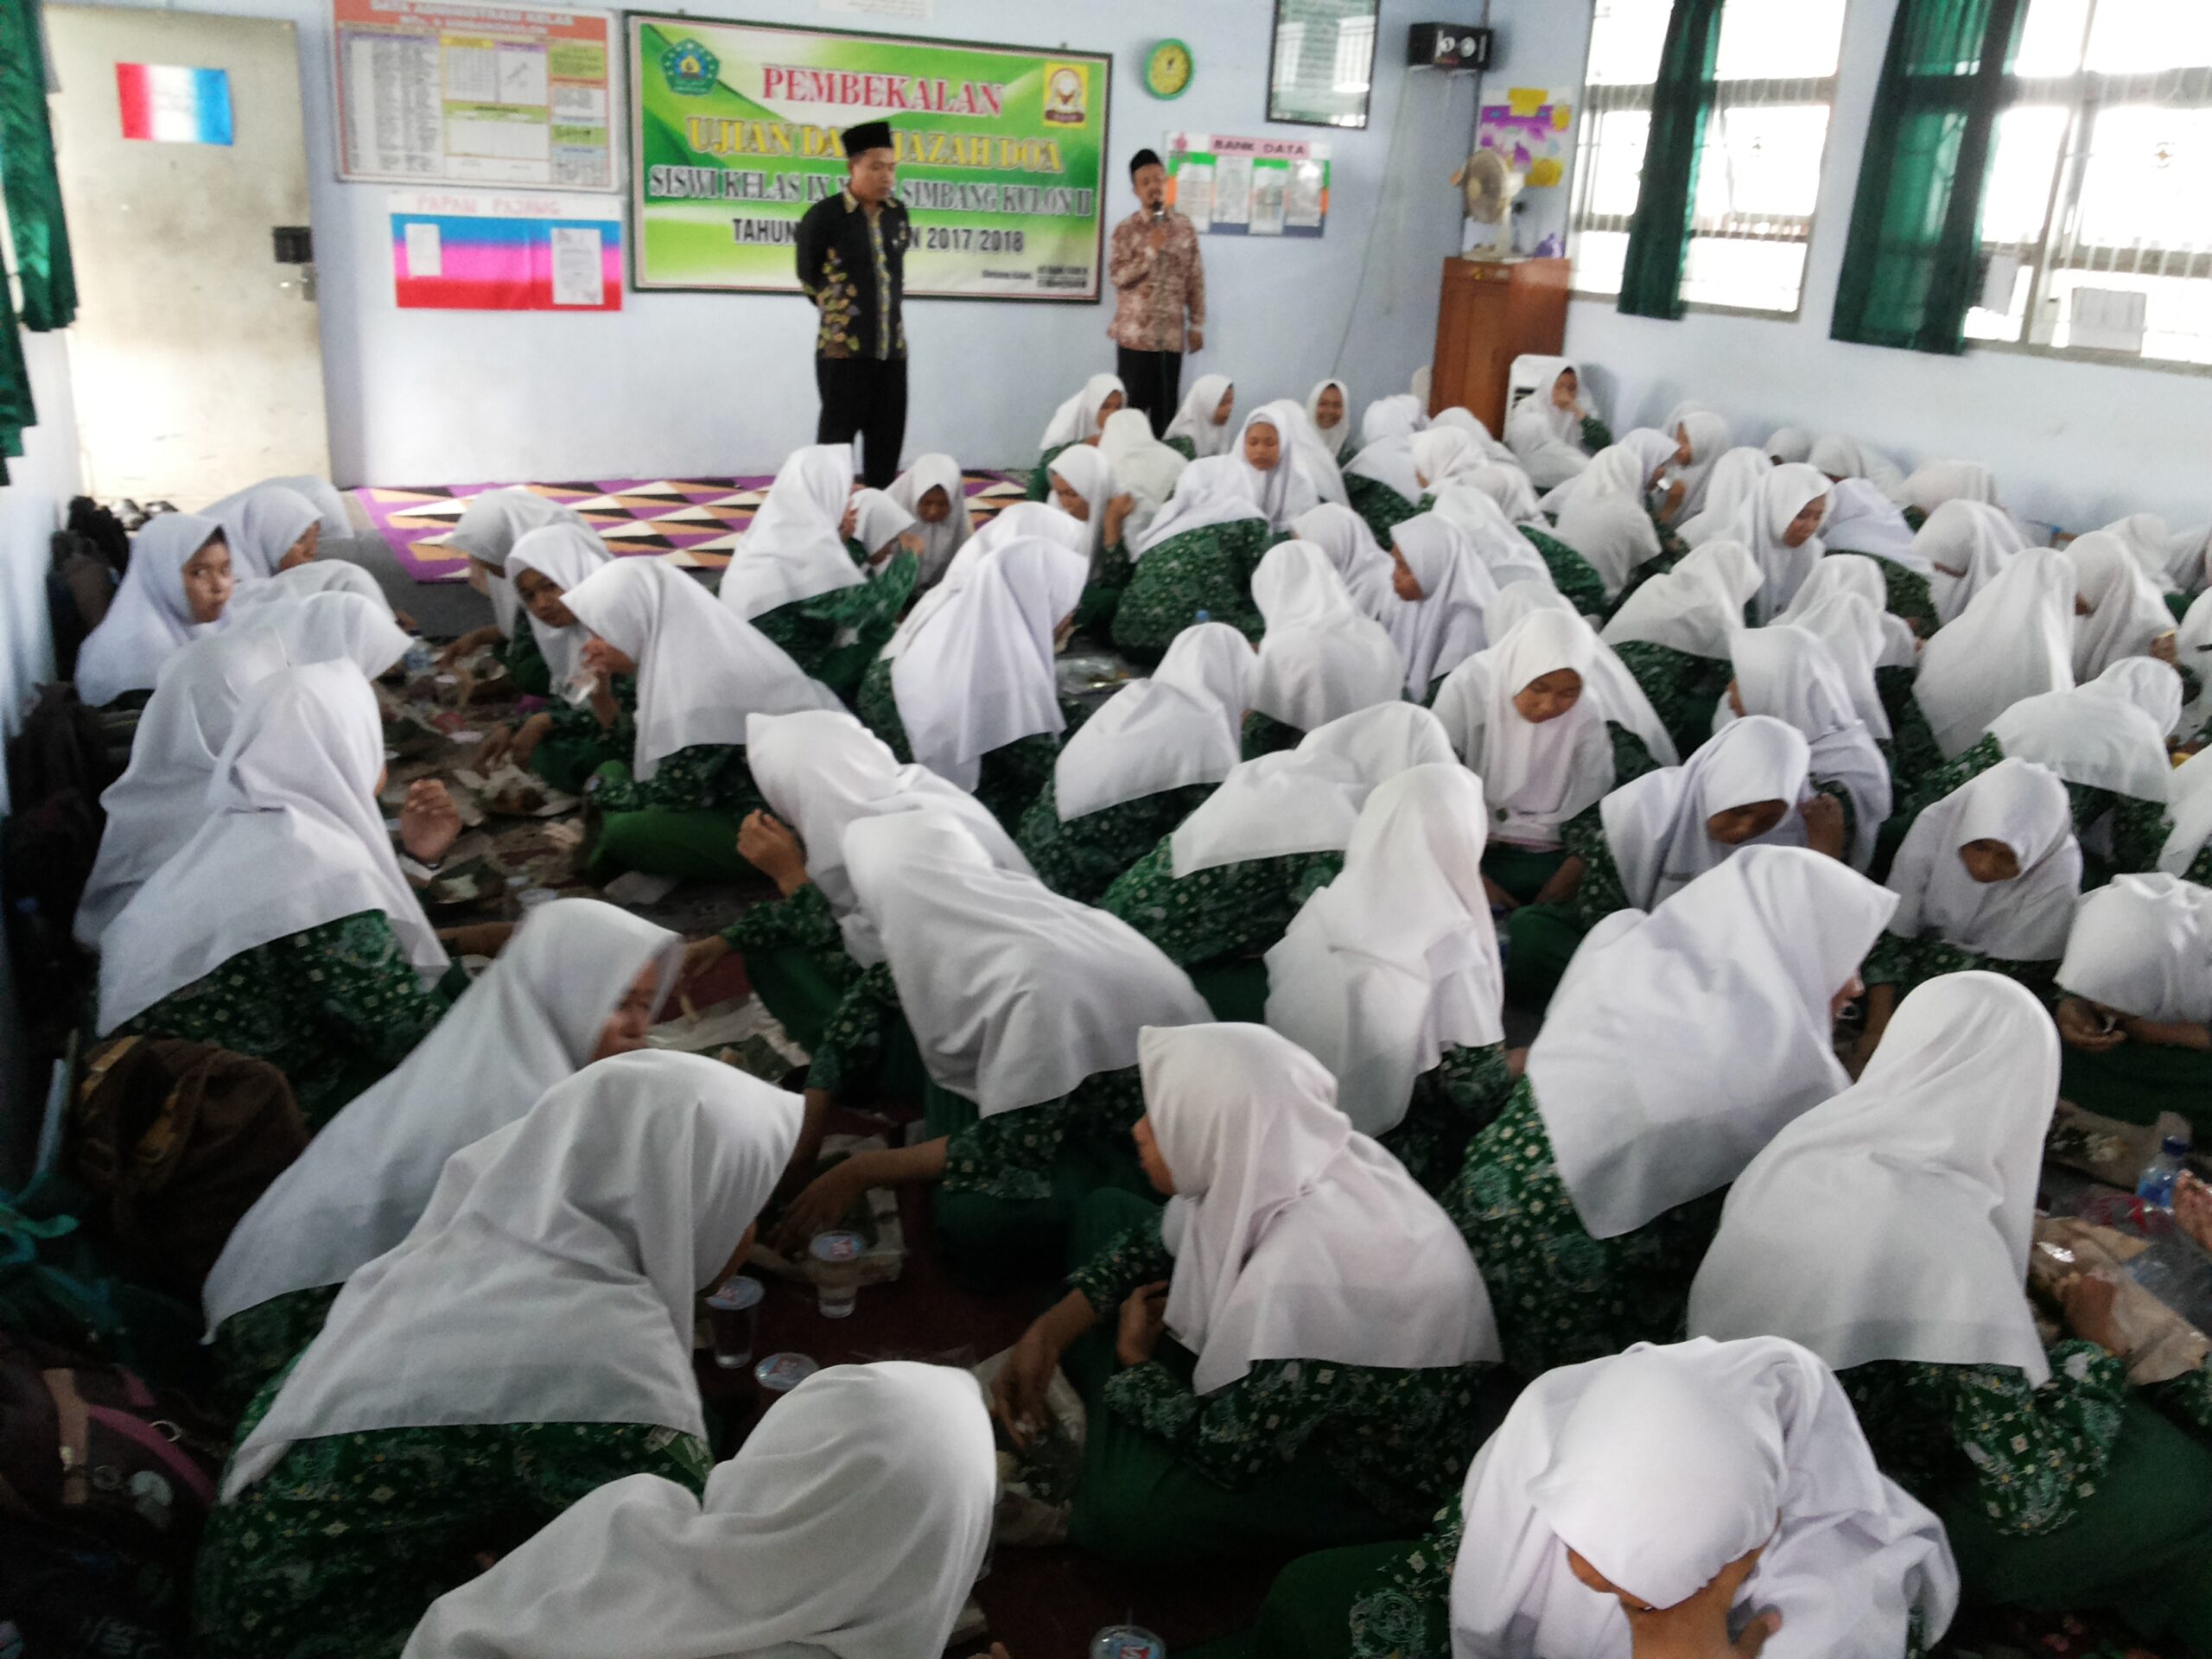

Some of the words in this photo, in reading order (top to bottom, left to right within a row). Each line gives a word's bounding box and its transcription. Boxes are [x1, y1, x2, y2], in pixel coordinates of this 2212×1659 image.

[762, 67, 1002, 115] PEMBEKALAN
[688, 118, 792, 155] UJIAN
[802, 125, 847, 157] DA
[1000, 138, 1063, 172] DOA
[1214, 140, 1255, 152] BANK
[1263, 143, 1305, 156] DATA
[651, 166, 718, 196] SISWI
[723, 171, 800, 200] KELAS
[902, 179, 996, 210] SIMBANG
[1002, 186, 1071, 214] KULON
